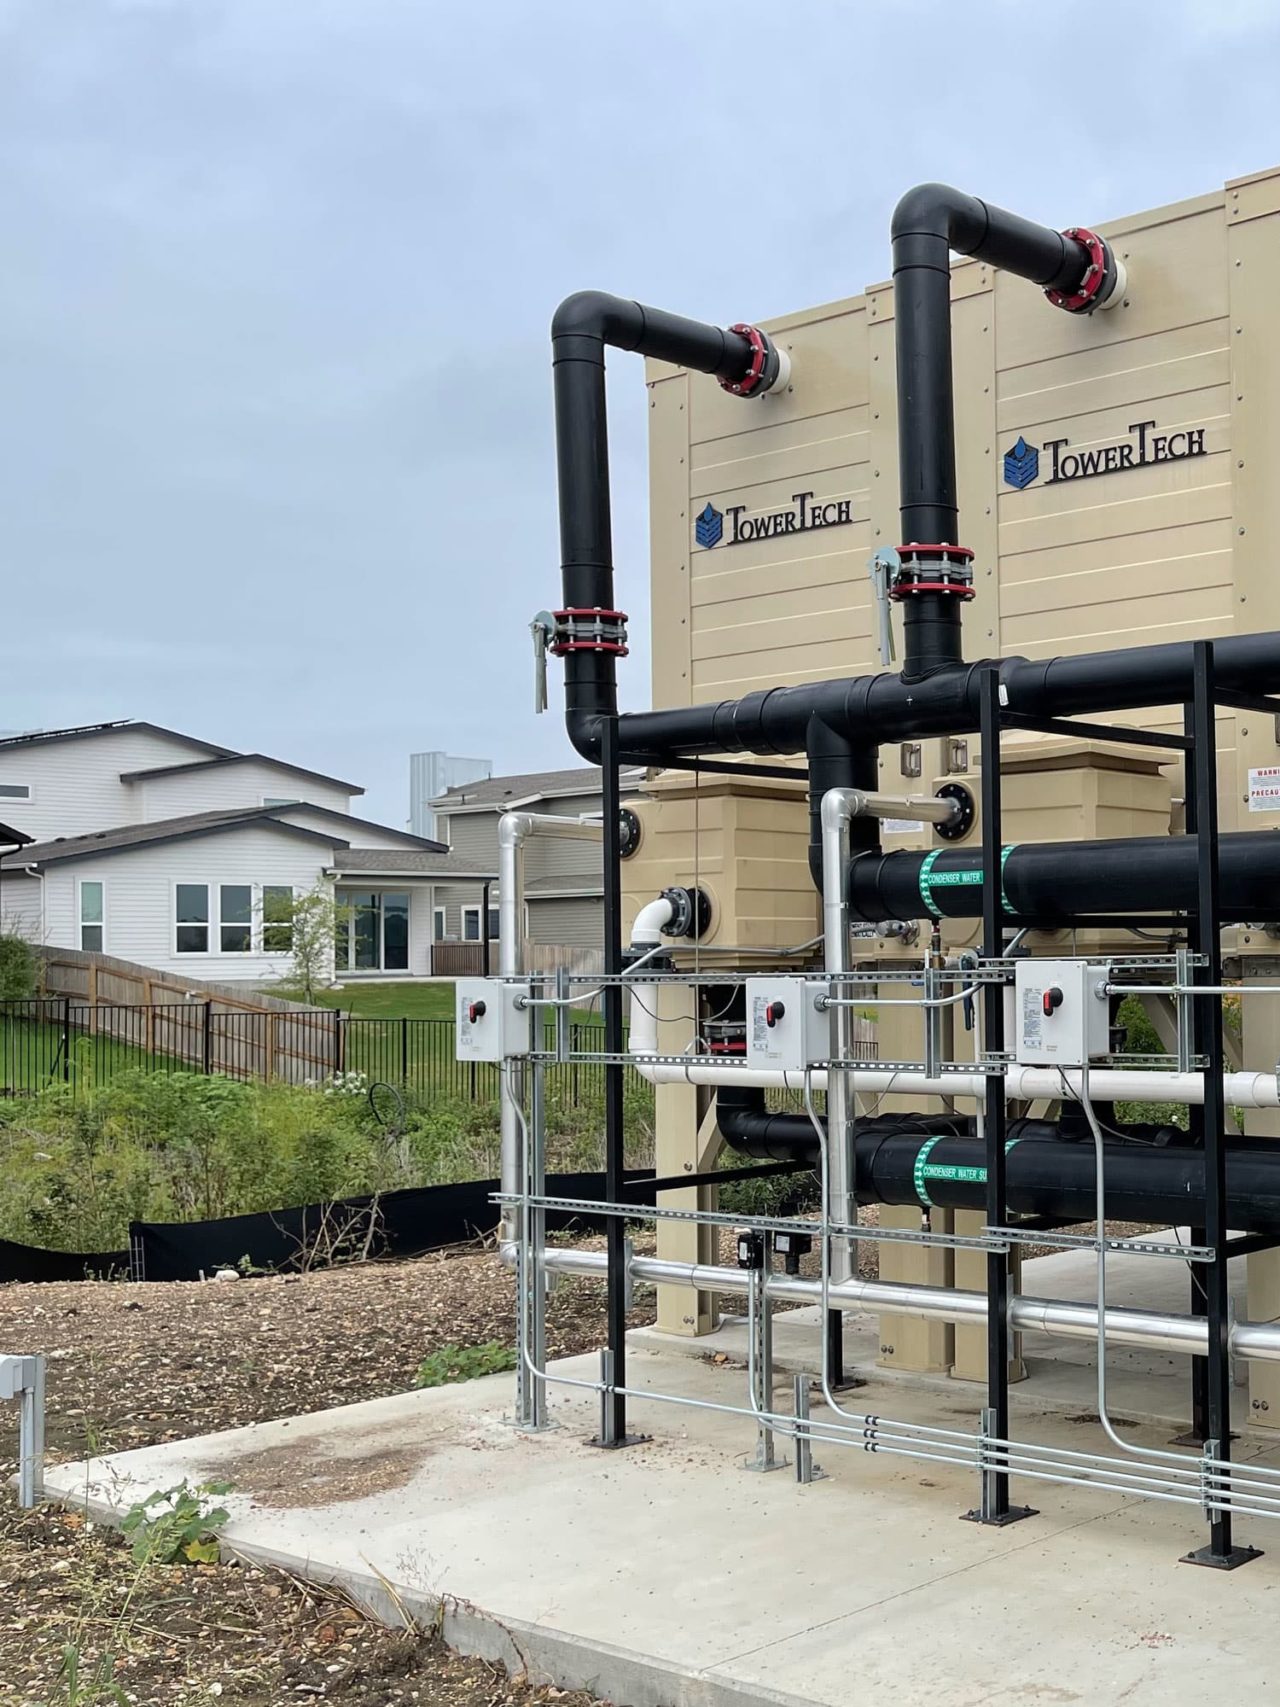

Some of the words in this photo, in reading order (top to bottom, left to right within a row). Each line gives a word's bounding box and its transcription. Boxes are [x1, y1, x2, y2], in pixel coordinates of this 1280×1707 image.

[928, 873, 960, 884] CONDENSER
[961, 872, 980, 882] WATER
[923, 1166, 956, 1178] CONDENSER
[958, 1168, 977, 1180] WATER
